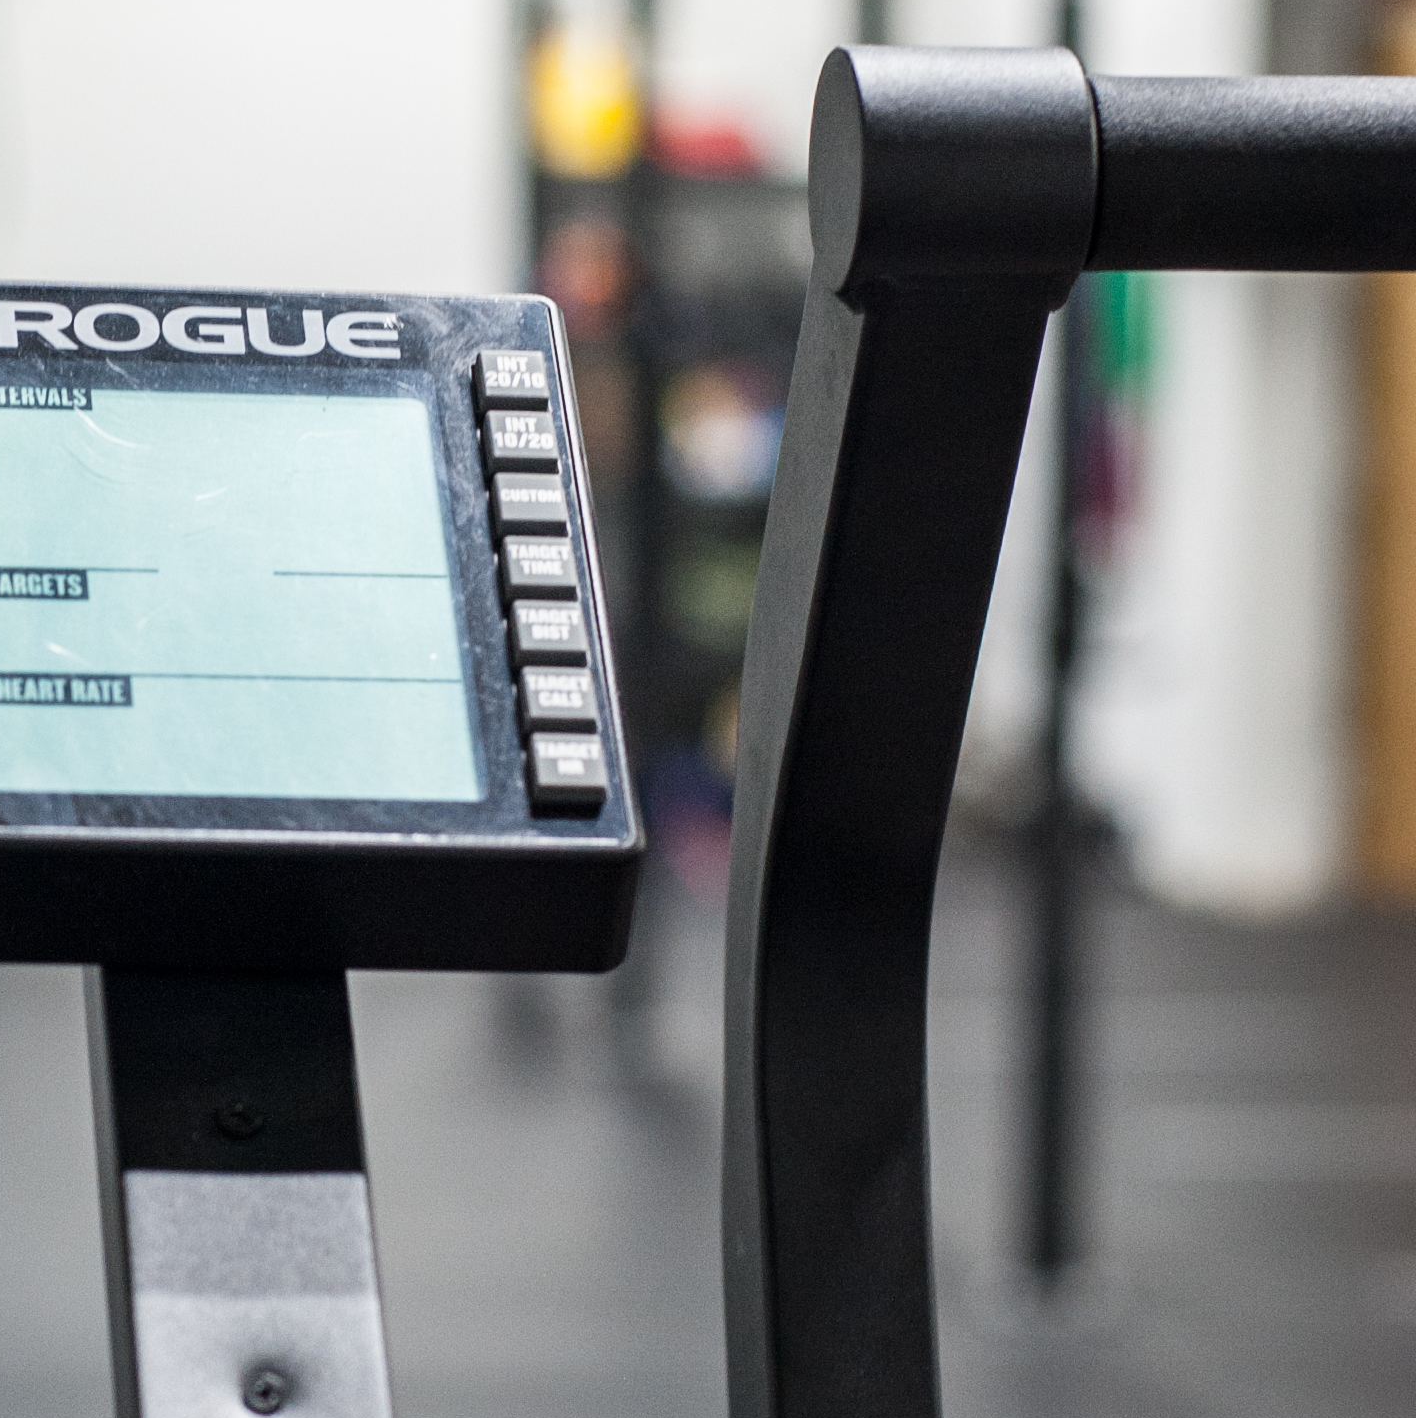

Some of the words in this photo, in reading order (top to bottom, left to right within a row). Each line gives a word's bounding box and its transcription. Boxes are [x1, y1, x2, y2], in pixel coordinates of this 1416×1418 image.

[496, 355, 528, 372] INT
[485, 370, 545, 389] 20/10
[504, 416, 537, 433] INT
[493, 431, 554, 450] 10/20
[500, 488, 562, 503] CUSTOM
[507, 544, 569, 560] TARGET
[520, 560, 564, 576] TIME
[517, 608, 579, 625] TARGET
[70, 678, 126, 704] RATE
[526, 674, 589, 692] TARGET
[538, 690, 584, 708] CALS
[536, 741, 601, 760] TARGET
